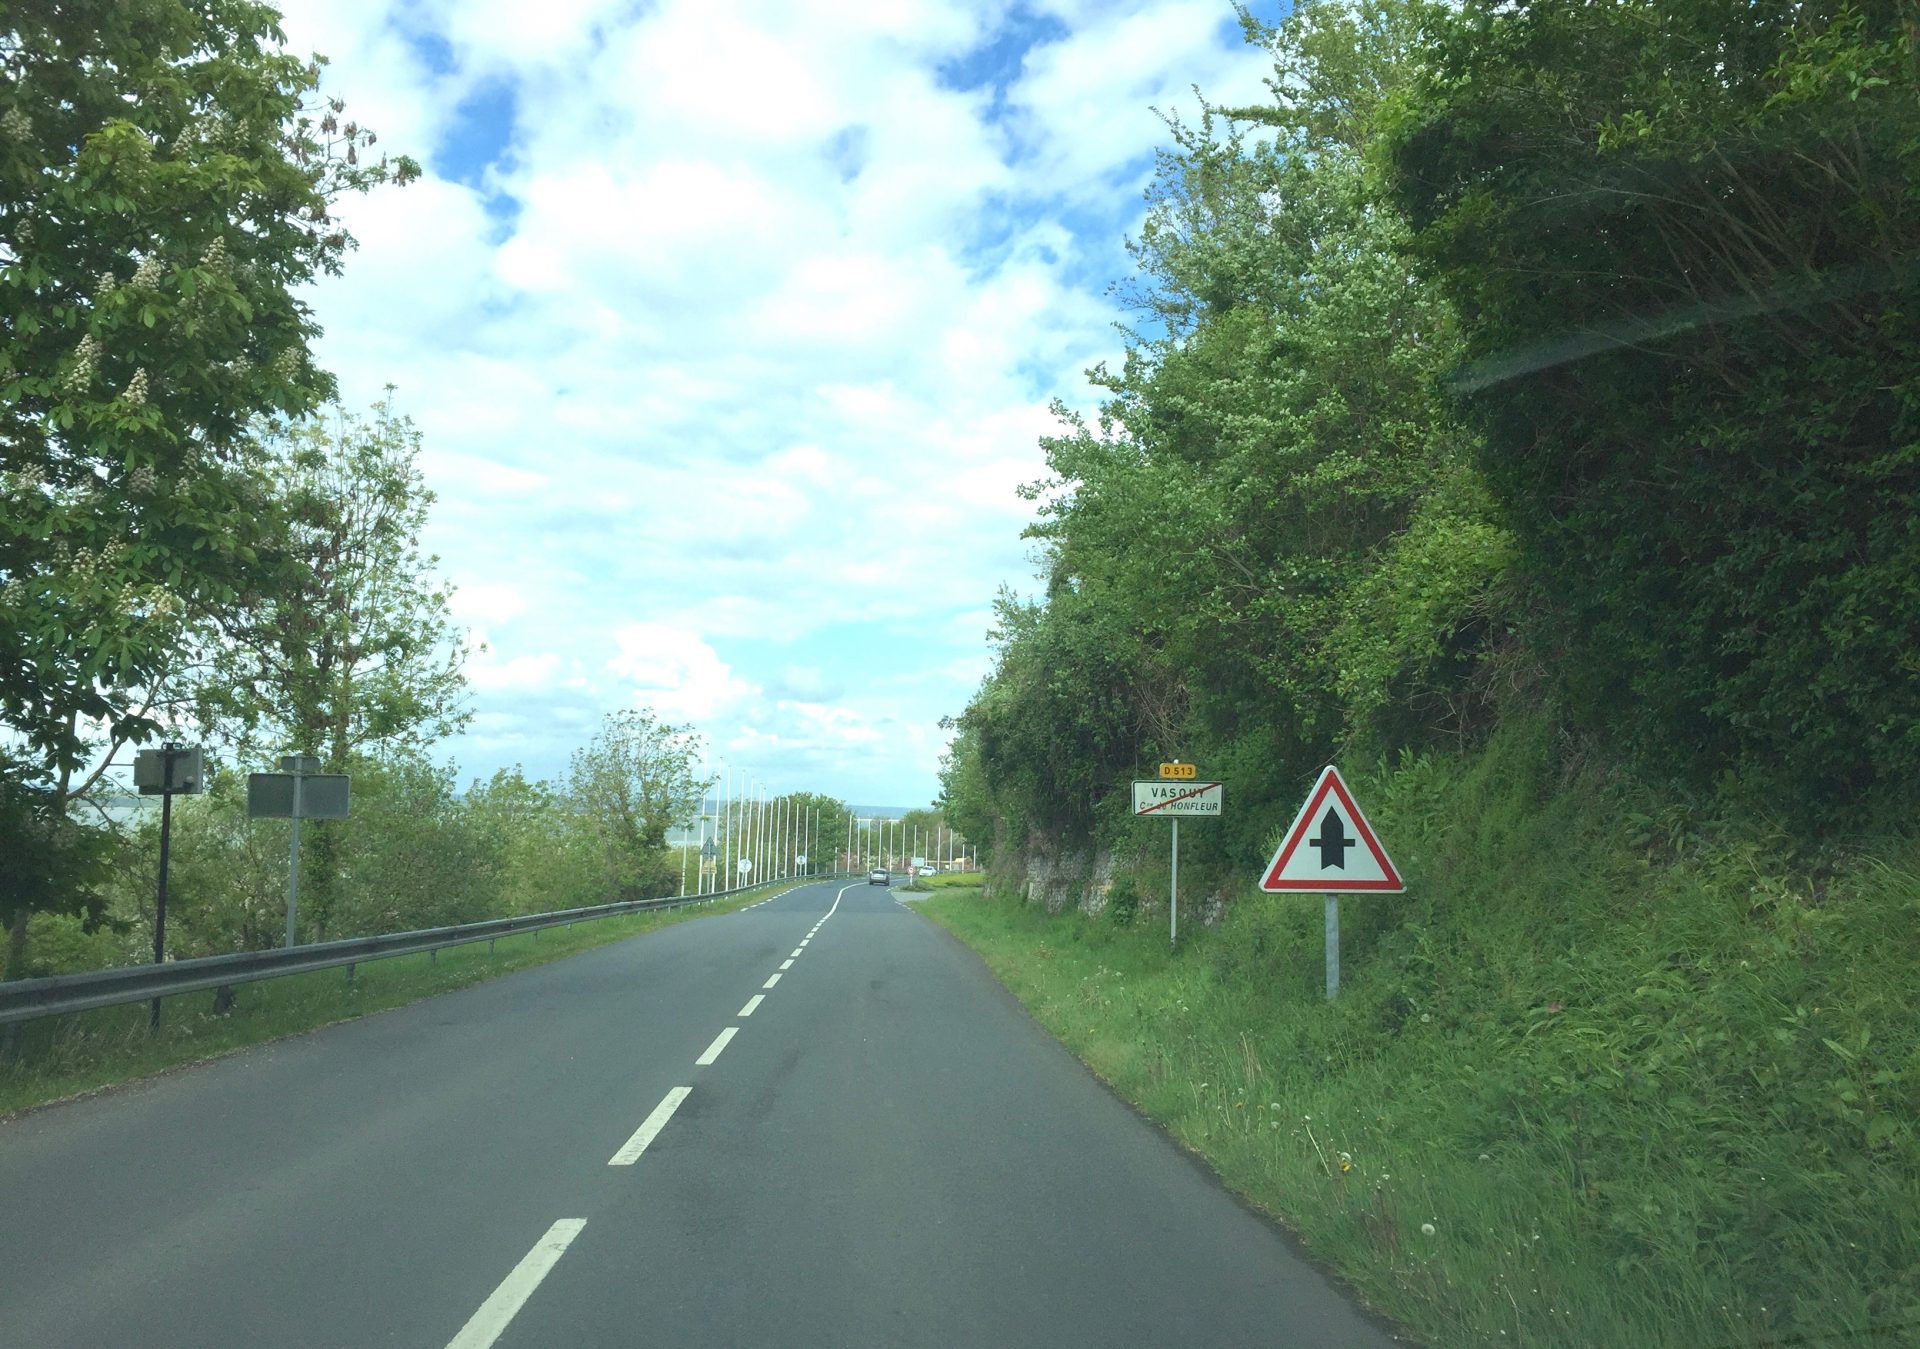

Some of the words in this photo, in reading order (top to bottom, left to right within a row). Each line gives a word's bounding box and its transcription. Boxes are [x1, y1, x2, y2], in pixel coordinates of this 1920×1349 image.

[1164, 767, 1170, 775] D
[1173, 767, 1193, 775] 513
[1170, 802, 1218, 811] HONFLEUR
